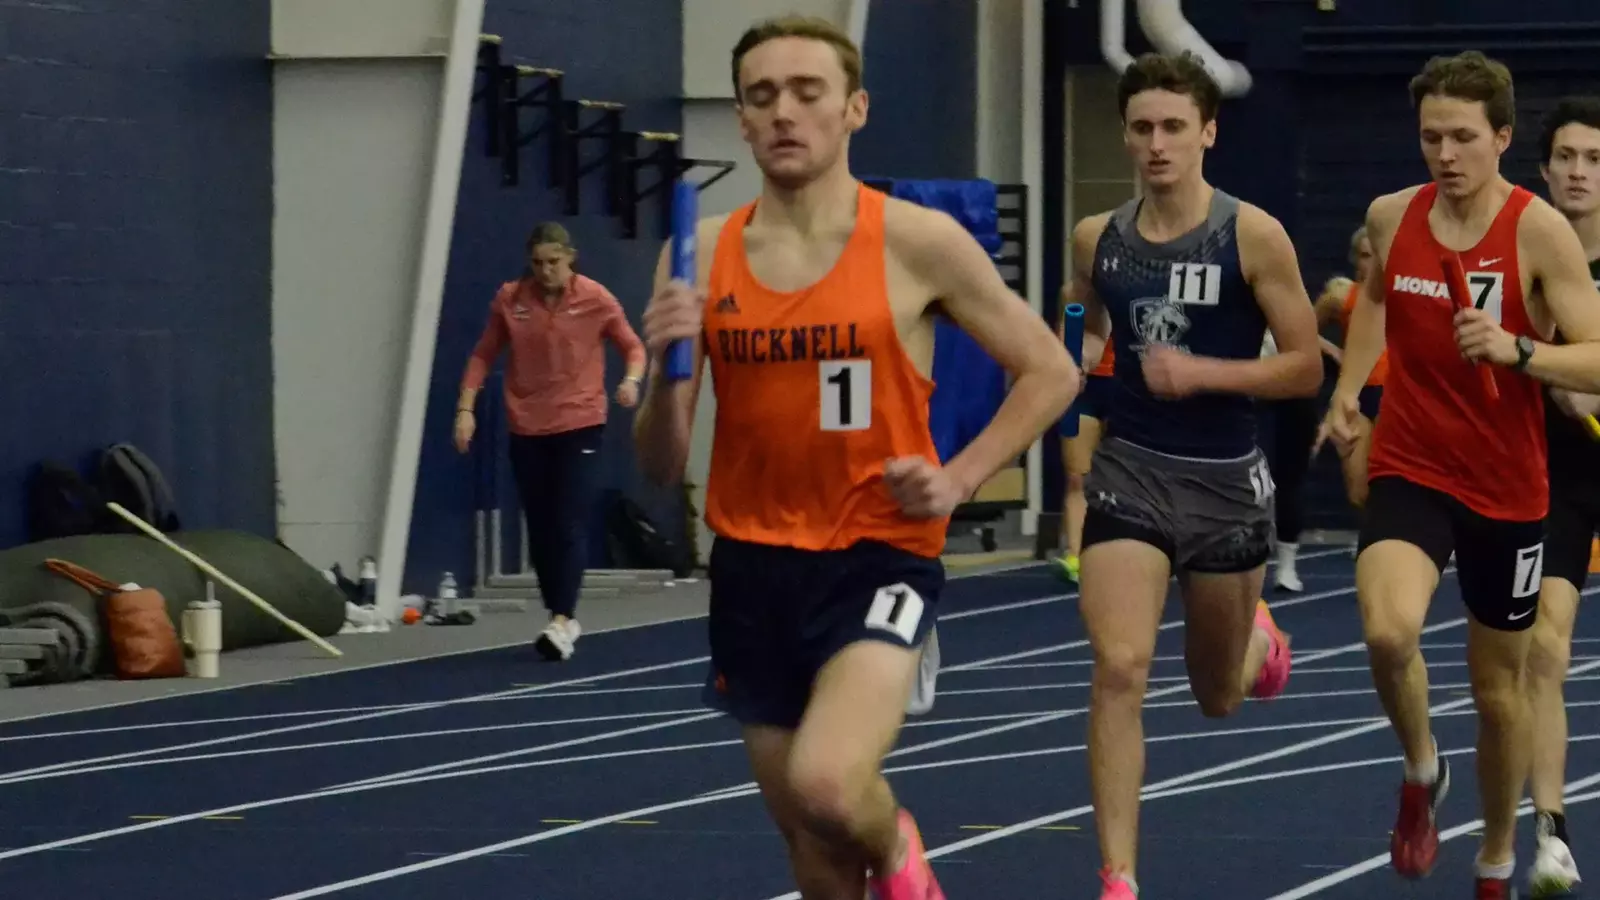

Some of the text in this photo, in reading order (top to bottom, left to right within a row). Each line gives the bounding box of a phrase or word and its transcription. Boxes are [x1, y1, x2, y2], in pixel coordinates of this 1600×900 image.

[1175, 265, 1207, 300] 11
[1469, 276, 1497, 310] 7
[717, 323, 865, 364] BUCKNELL
[828, 367, 852, 425] 1
[1521, 546, 1540, 592] 7
[885, 585, 910, 625] 1
